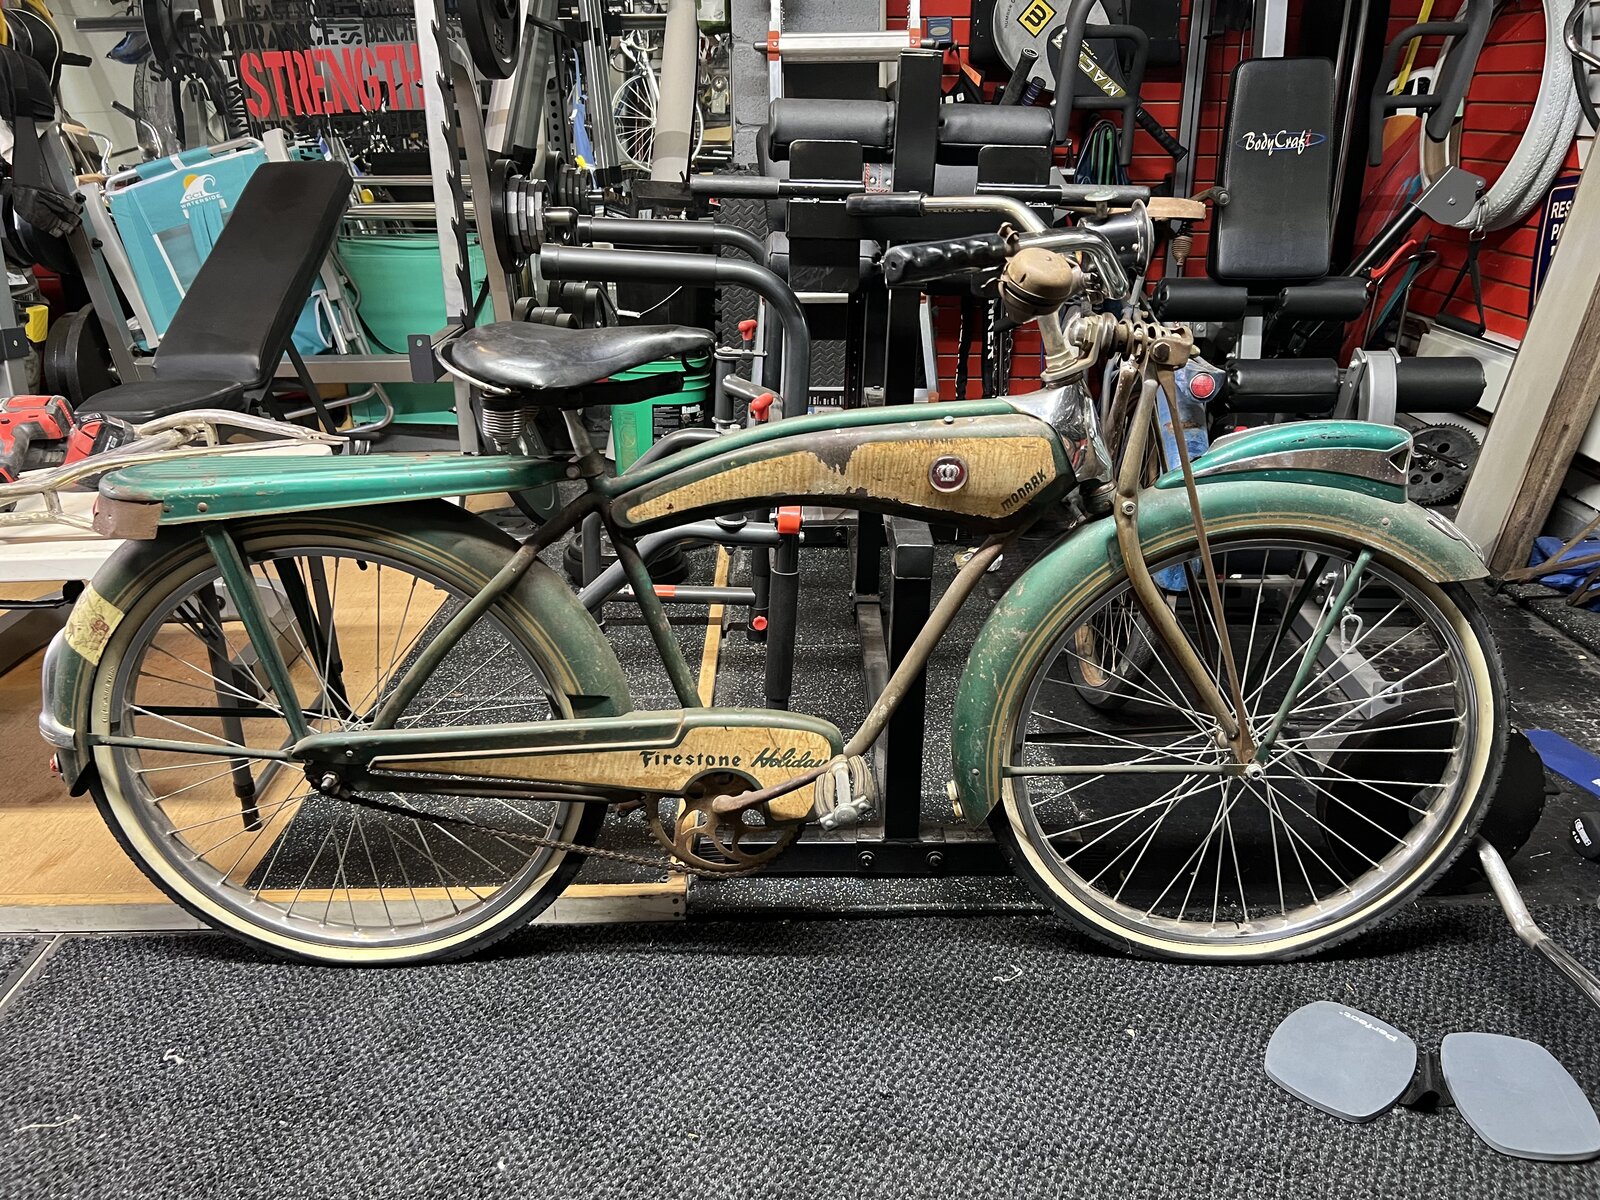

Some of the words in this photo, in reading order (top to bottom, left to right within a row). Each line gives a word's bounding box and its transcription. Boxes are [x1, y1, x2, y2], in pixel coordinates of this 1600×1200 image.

[239, 42, 425, 119] STRENGTH
[1078, 50, 1121, 97] MAC
[1242, 129, 1313, 157] BodyCraft
[180, 193, 221, 209] WATERSIDE
[185, 190, 204, 201] GCI
[639, 751, 742, 768] Firestone
[1343, 1011, 1399, 1043] Perfect
